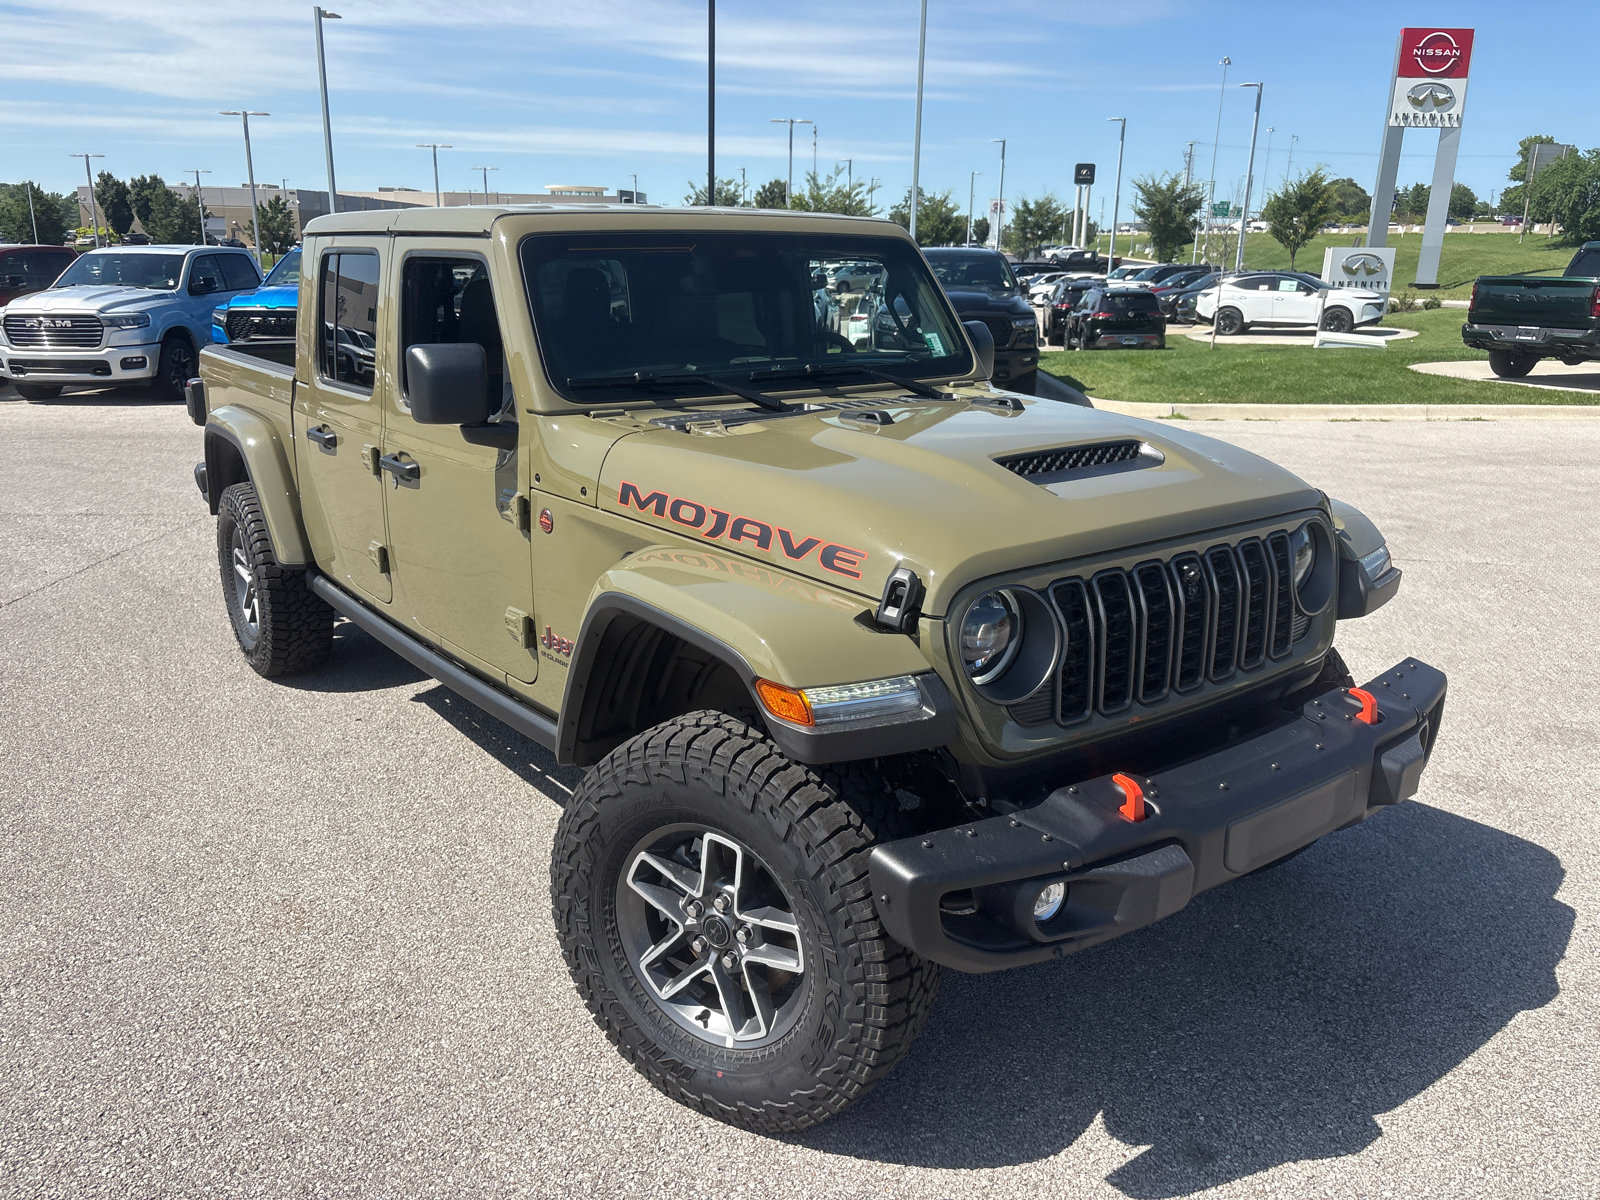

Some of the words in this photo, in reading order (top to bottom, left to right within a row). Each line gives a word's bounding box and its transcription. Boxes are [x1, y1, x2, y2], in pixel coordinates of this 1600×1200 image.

[1413, 48, 1460, 56] NISSAN
[1395, 112, 1460, 121] INFINITI
[1332, 280, 1388, 289] INFINITI
[617, 480, 869, 580] MOJAVE
